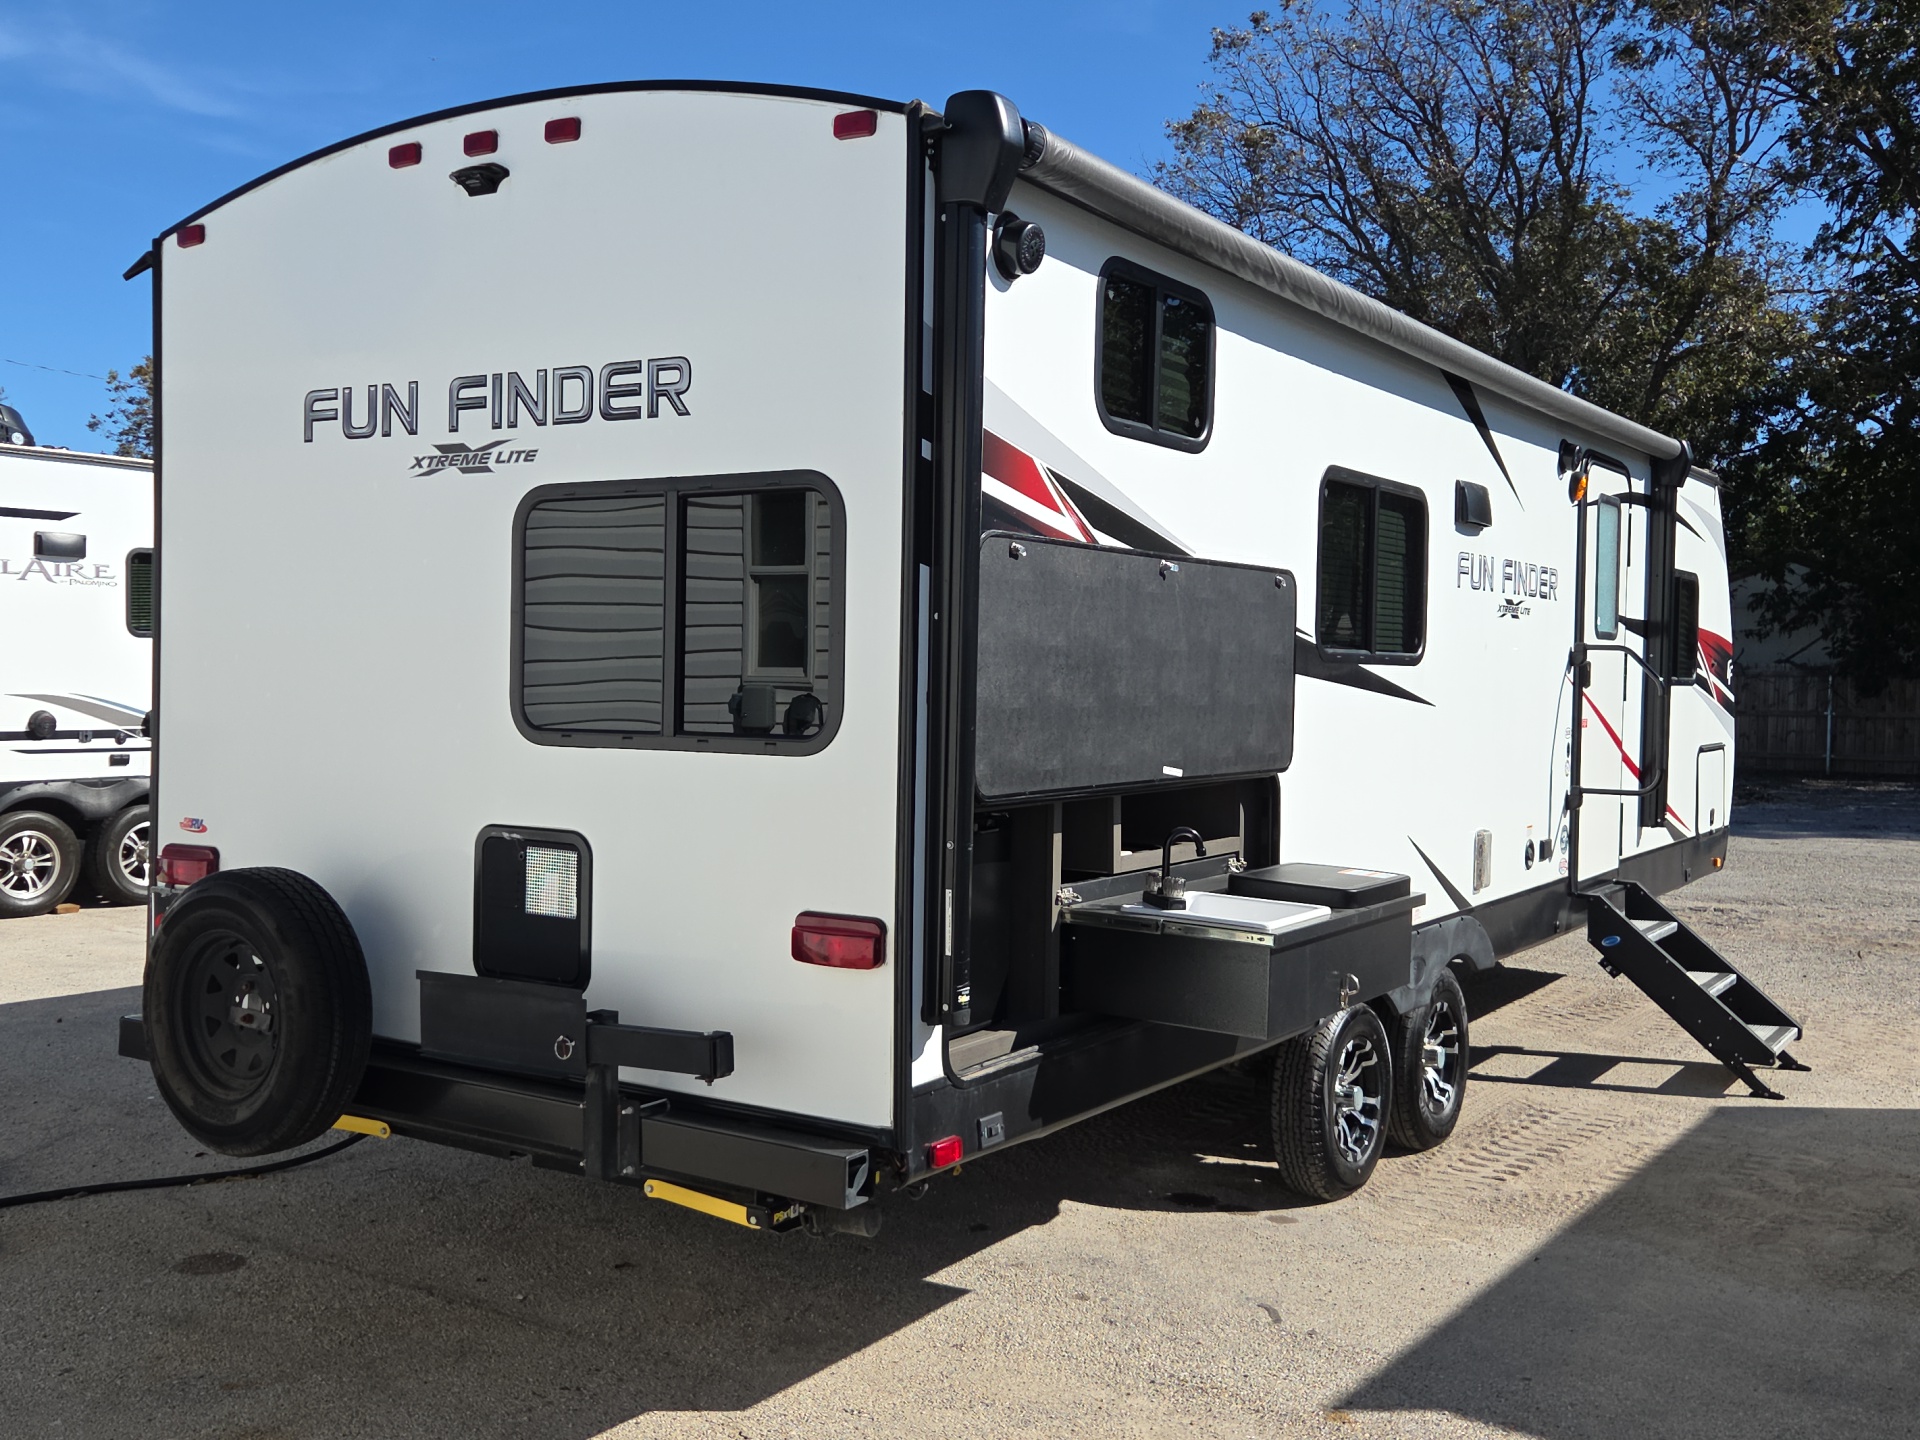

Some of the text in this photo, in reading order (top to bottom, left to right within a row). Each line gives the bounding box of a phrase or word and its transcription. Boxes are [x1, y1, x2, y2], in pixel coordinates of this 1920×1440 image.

[303, 356, 692, 443] FUN FINDER
[408, 449, 539, 470] XTREME LITE
[1457, 551, 1559, 601] FUN FINDER
